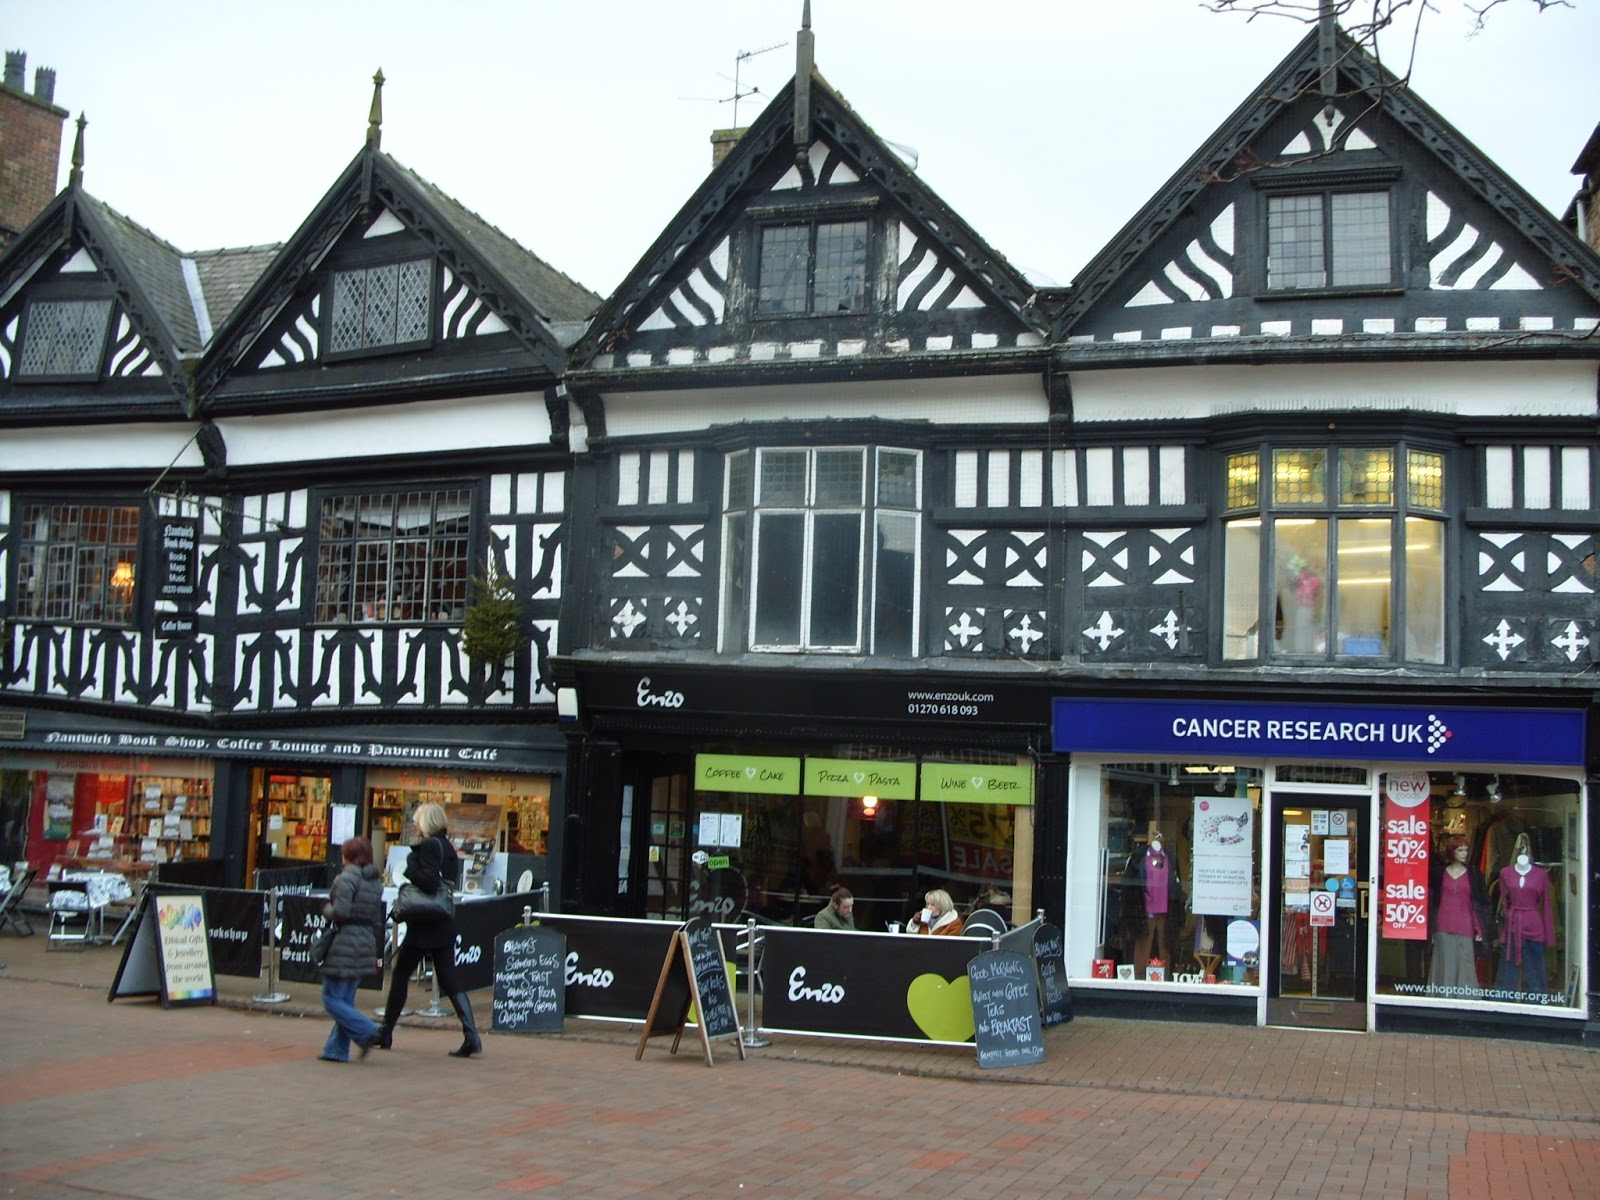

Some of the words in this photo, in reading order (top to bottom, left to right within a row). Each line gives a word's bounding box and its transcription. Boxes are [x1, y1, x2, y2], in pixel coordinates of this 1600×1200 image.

[164, 524, 194, 538] Nantwich
[169, 552, 186, 561] Books
[637, 676, 684, 708] Enzo
[908, 690, 994, 702] www.enzouk.com
[908, 704, 938, 714] 01270
[939, 705, 958, 715] 618
[960, 706, 978, 716] 093
[1172, 718, 1260, 739] CANCER
[1267, 720, 1385, 742] RESEARCH
[1392, 724, 1423, 743] UK
[45, 732, 111, 745] Nantwich
[118, 734, 157, 746] Book
[165, 736, 210, 749] Shop,
[217, 738, 263, 750] Coffee
[269, 740, 327, 753] Lounge
[333, 743, 361, 754] and
[368, 744, 450, 759] Pavement
[458, 748, 497, 761] Café
[1389, 780, 1426, 793] new
[1387, 815, 1427, 835] sale
[1387, 839, 1427, 859] 50%
[709, 858, 728, 867] open
[1386, 879, 1426, 900] sale
[1385, 904, 1426, 924] 50%
[165, 936, 187, 945] Ethical
[189, 936, 204, 945] Gifts
[208, 927, 248, 942] ookshop
[175, 949, 204, 959] Jewellery
[166, 963, 182, 972] from
[184, 961, 208, 969] around
[564, 951, 614, 988] Enzo
[185, 974, 203, 982] world
[788, 966, 845, 1004] Enzo
[1172, 970, 1204, 985] LOVE
[1394, 982, 1565, 1004] www.shoptobeatcancer.org.uk
